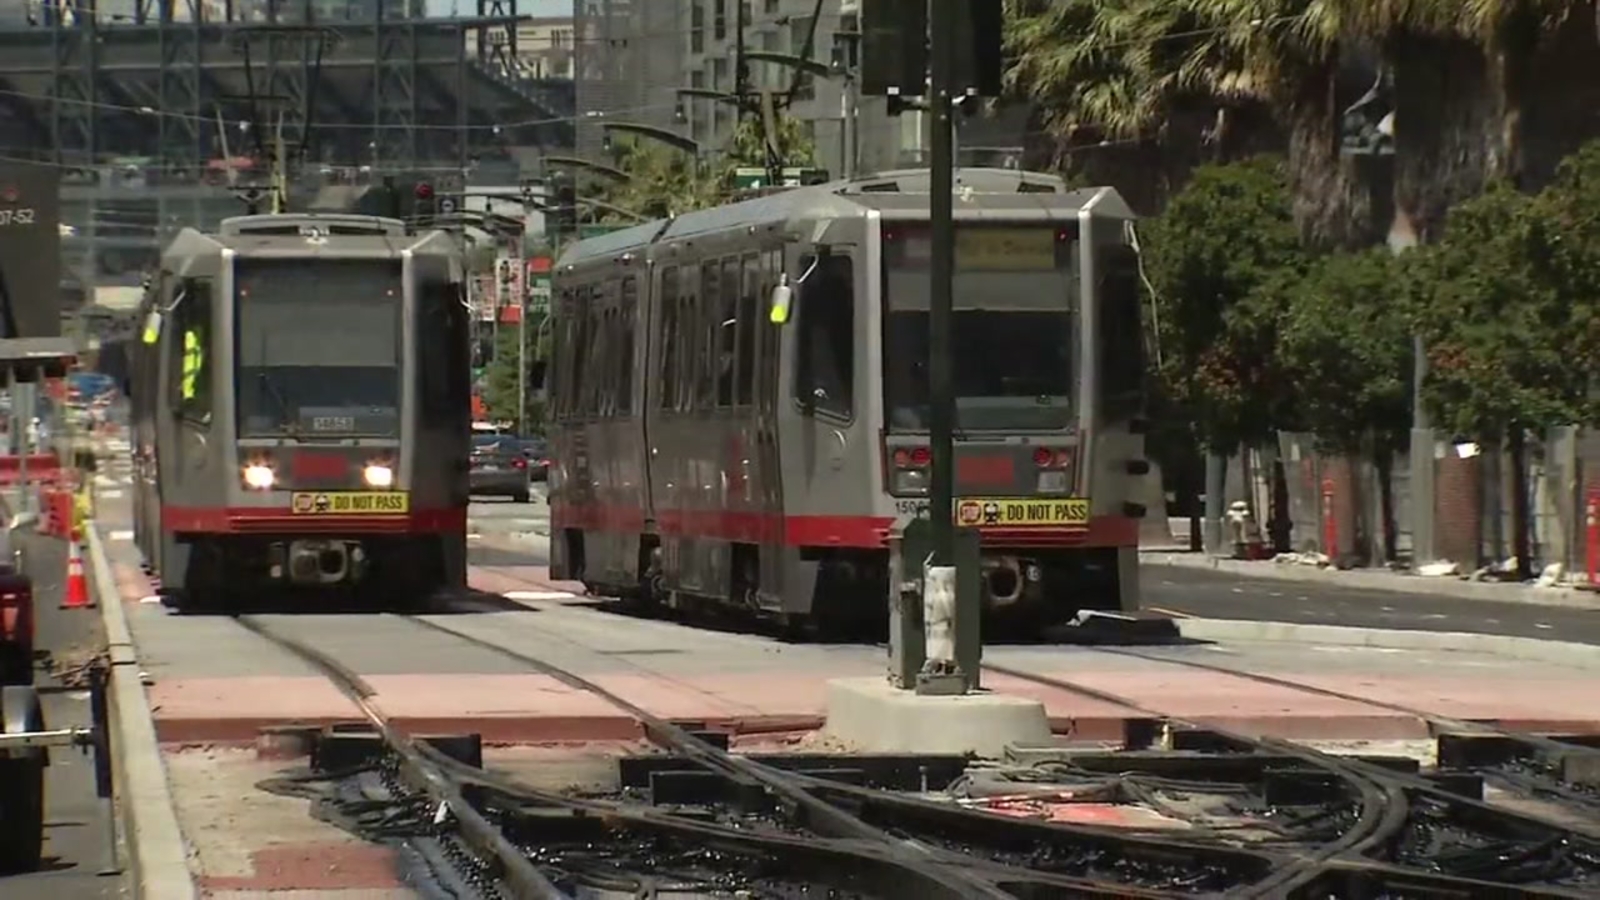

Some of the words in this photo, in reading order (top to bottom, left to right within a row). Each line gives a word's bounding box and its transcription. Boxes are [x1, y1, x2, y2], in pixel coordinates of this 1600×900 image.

[334, 495, 350, 509] DO
[352, 495, 373, 509] NOT
[375, 495, 403, 509] PASS
[1007, 504, 1024, 521] DO
[1027, 504, 1052, 520] NOT
[1054, 504, 1087, 520] PASS
